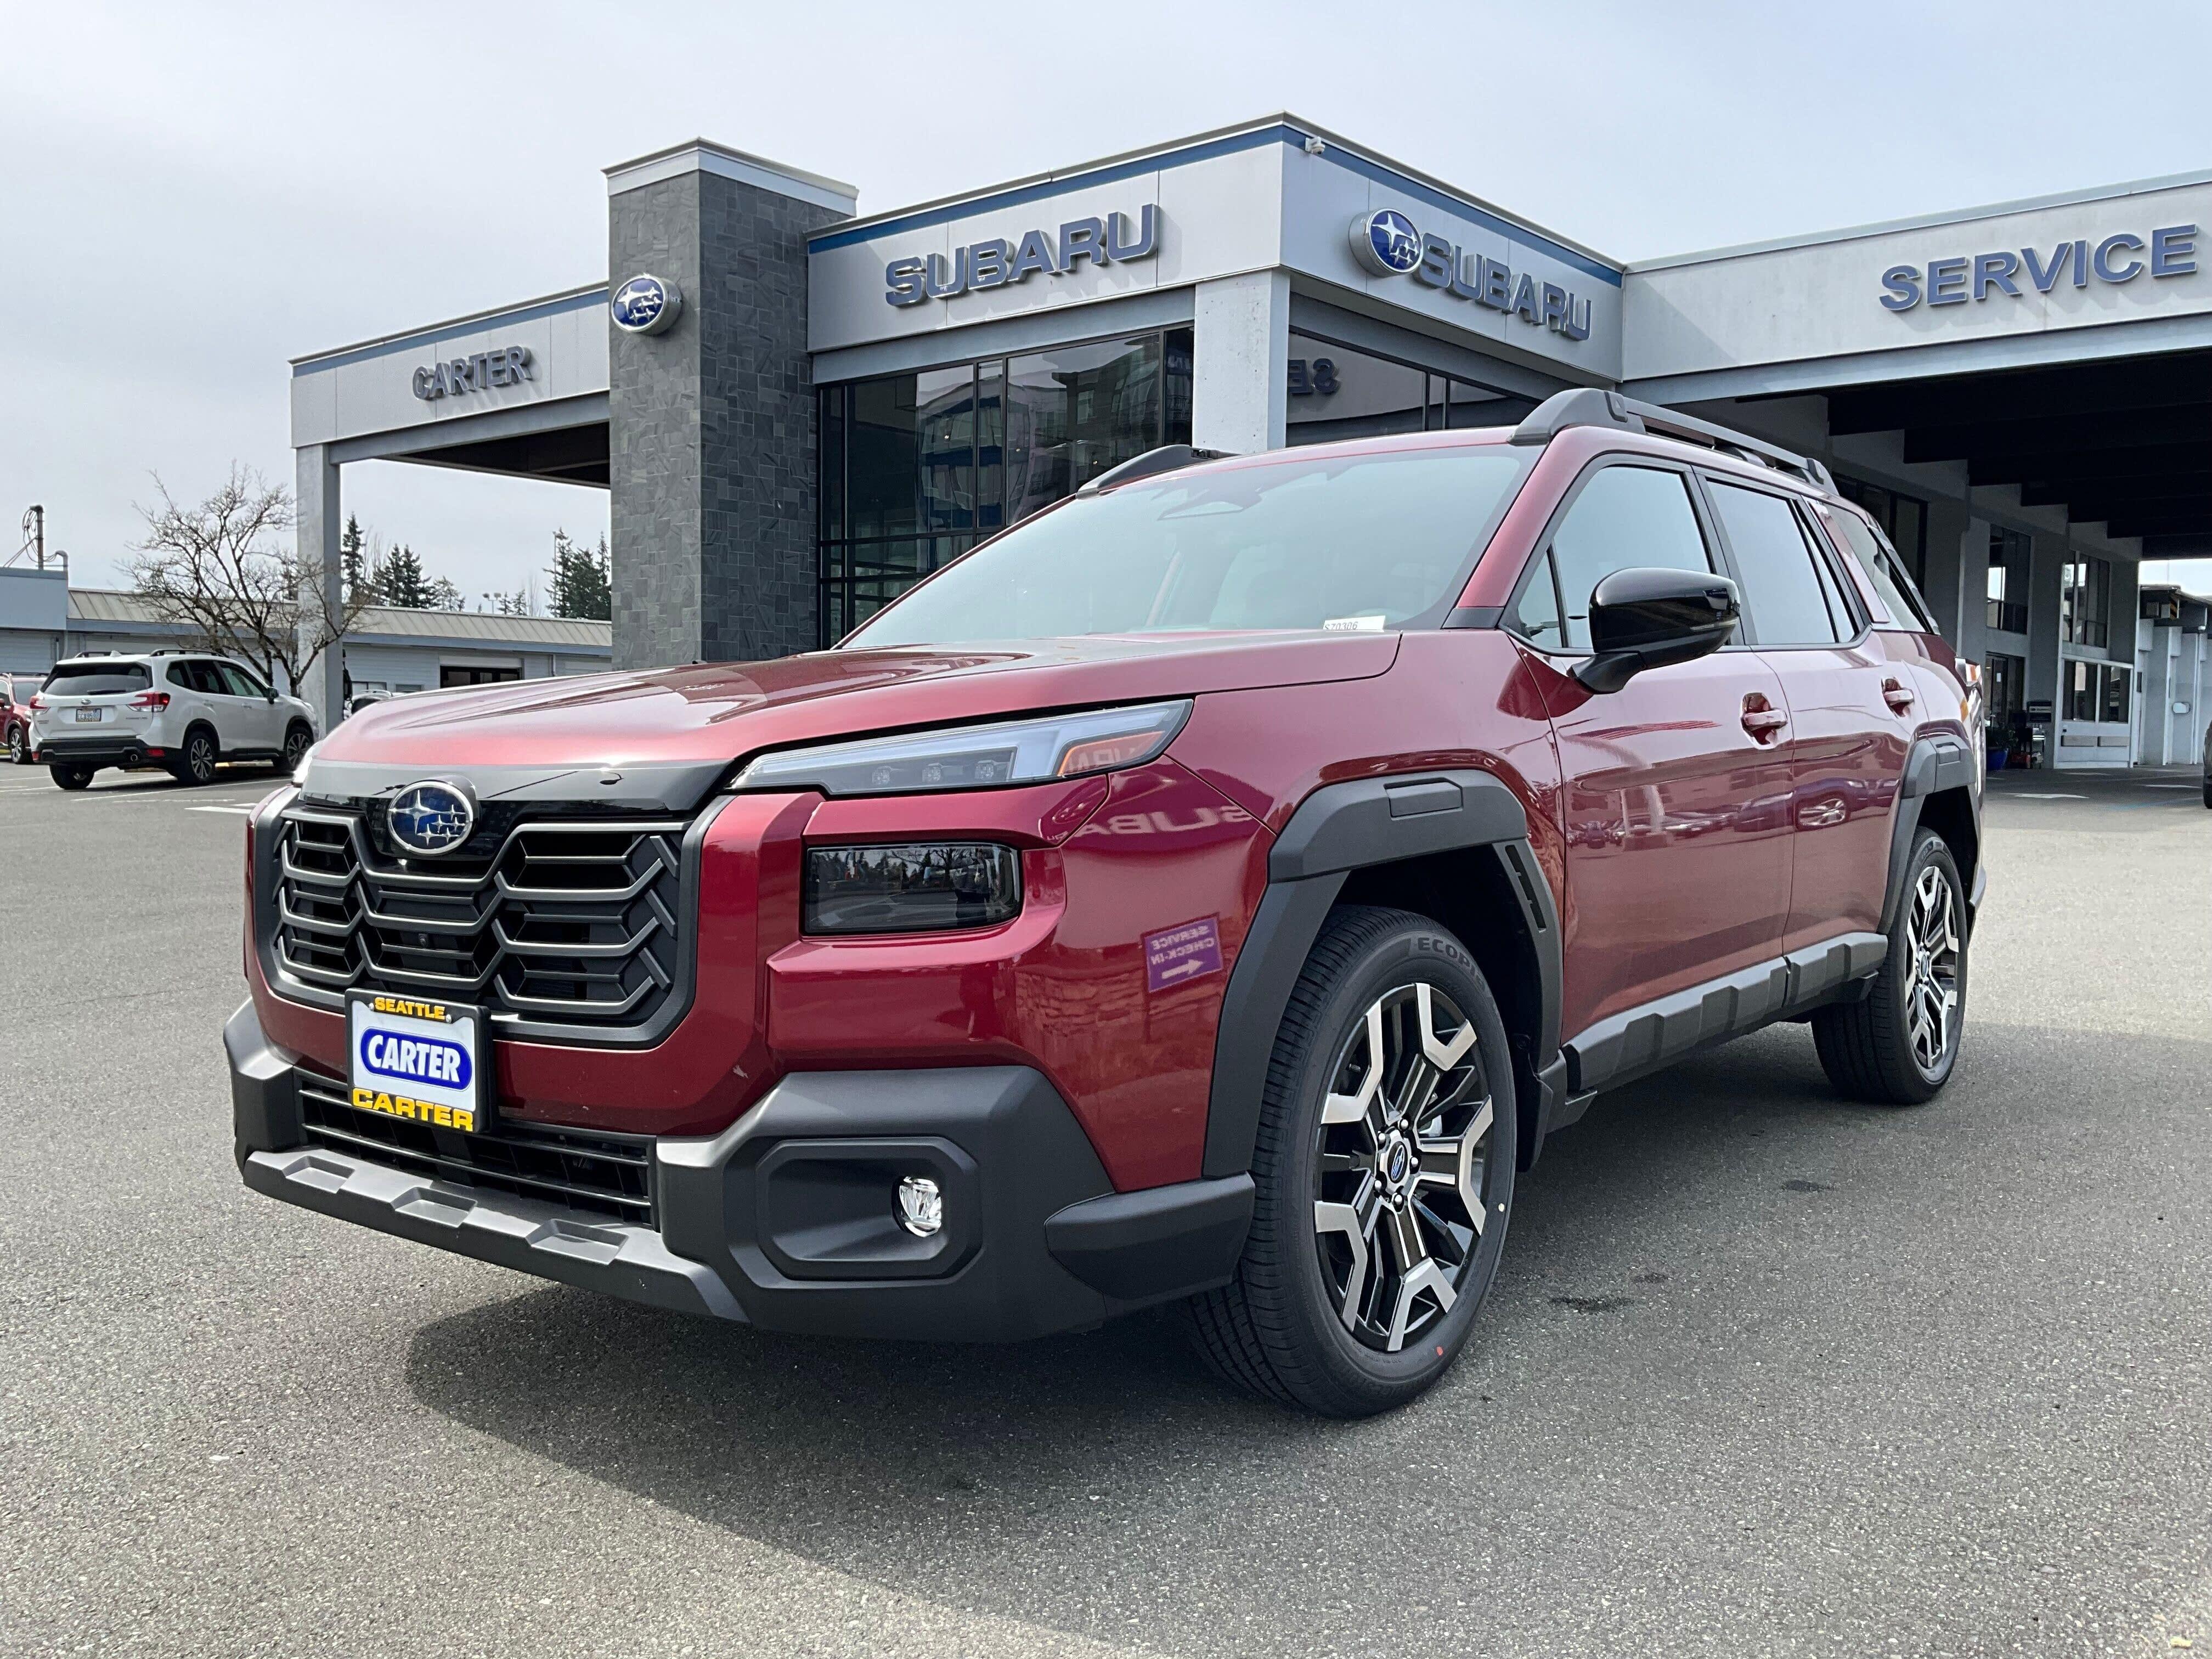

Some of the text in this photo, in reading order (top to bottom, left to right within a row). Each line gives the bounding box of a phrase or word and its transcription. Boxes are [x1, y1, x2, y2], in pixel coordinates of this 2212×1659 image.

[885, 204, 1159, 306] SUBARU
[1879, 223, 2197, 311] SERVICE
[1412, 232, 1592, 341] SUBARU
[413, 345, 531, 400] CARTER
[374, 996, 445, 1020] SEATTLE
[368, 1034, 461, 1082] CARTER
[352, 1087, 473, 1132] CARTER
